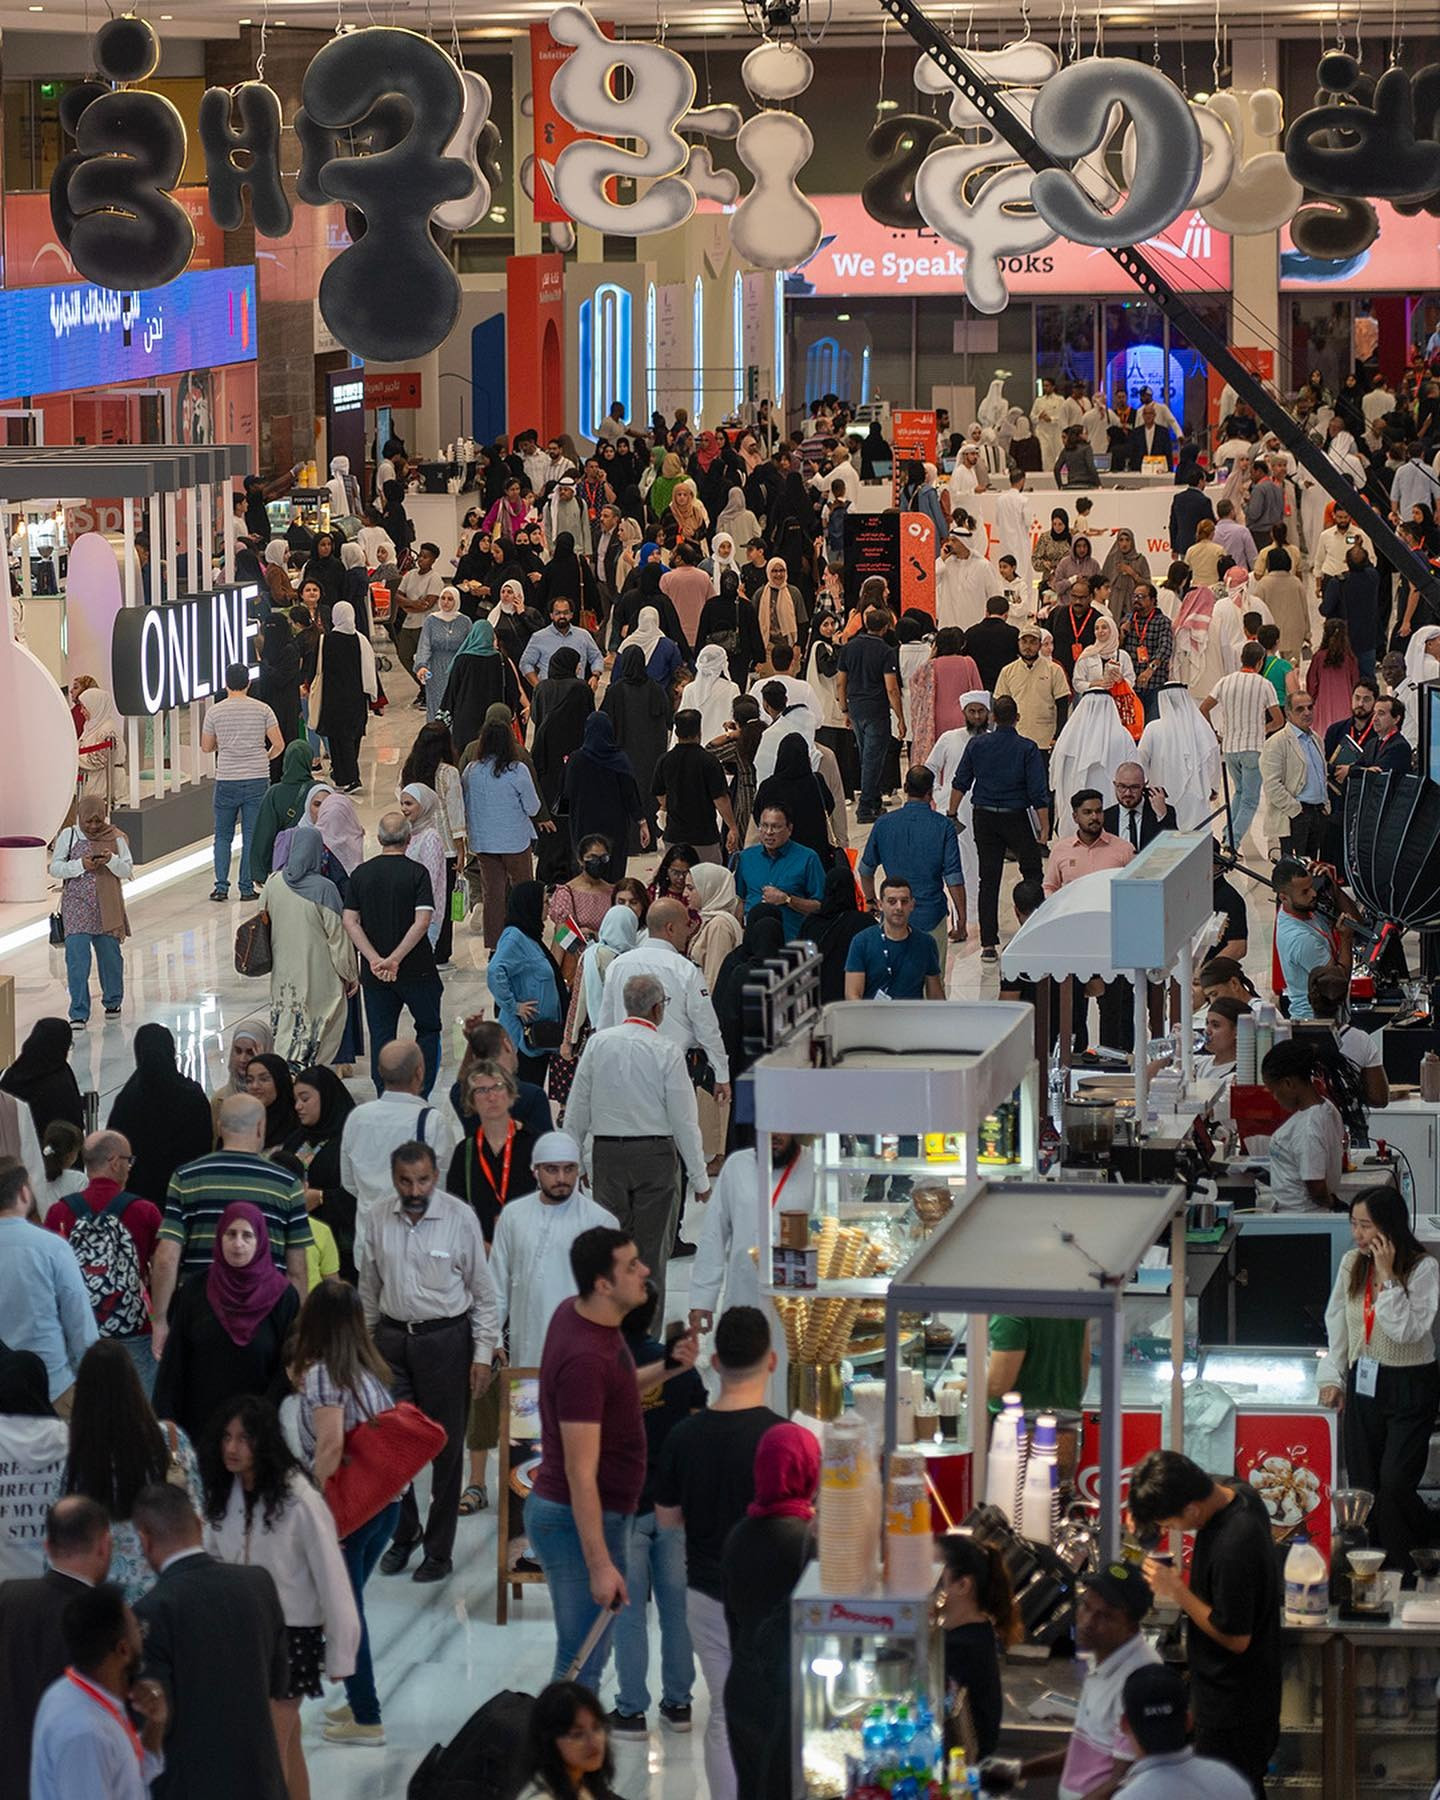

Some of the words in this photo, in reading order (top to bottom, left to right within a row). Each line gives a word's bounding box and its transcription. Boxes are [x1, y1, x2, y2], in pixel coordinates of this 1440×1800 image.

[831, 253, 875, 277] We
[881, 250, 967, 284] Speak
[141, 584, 260, 714] ONLINE
